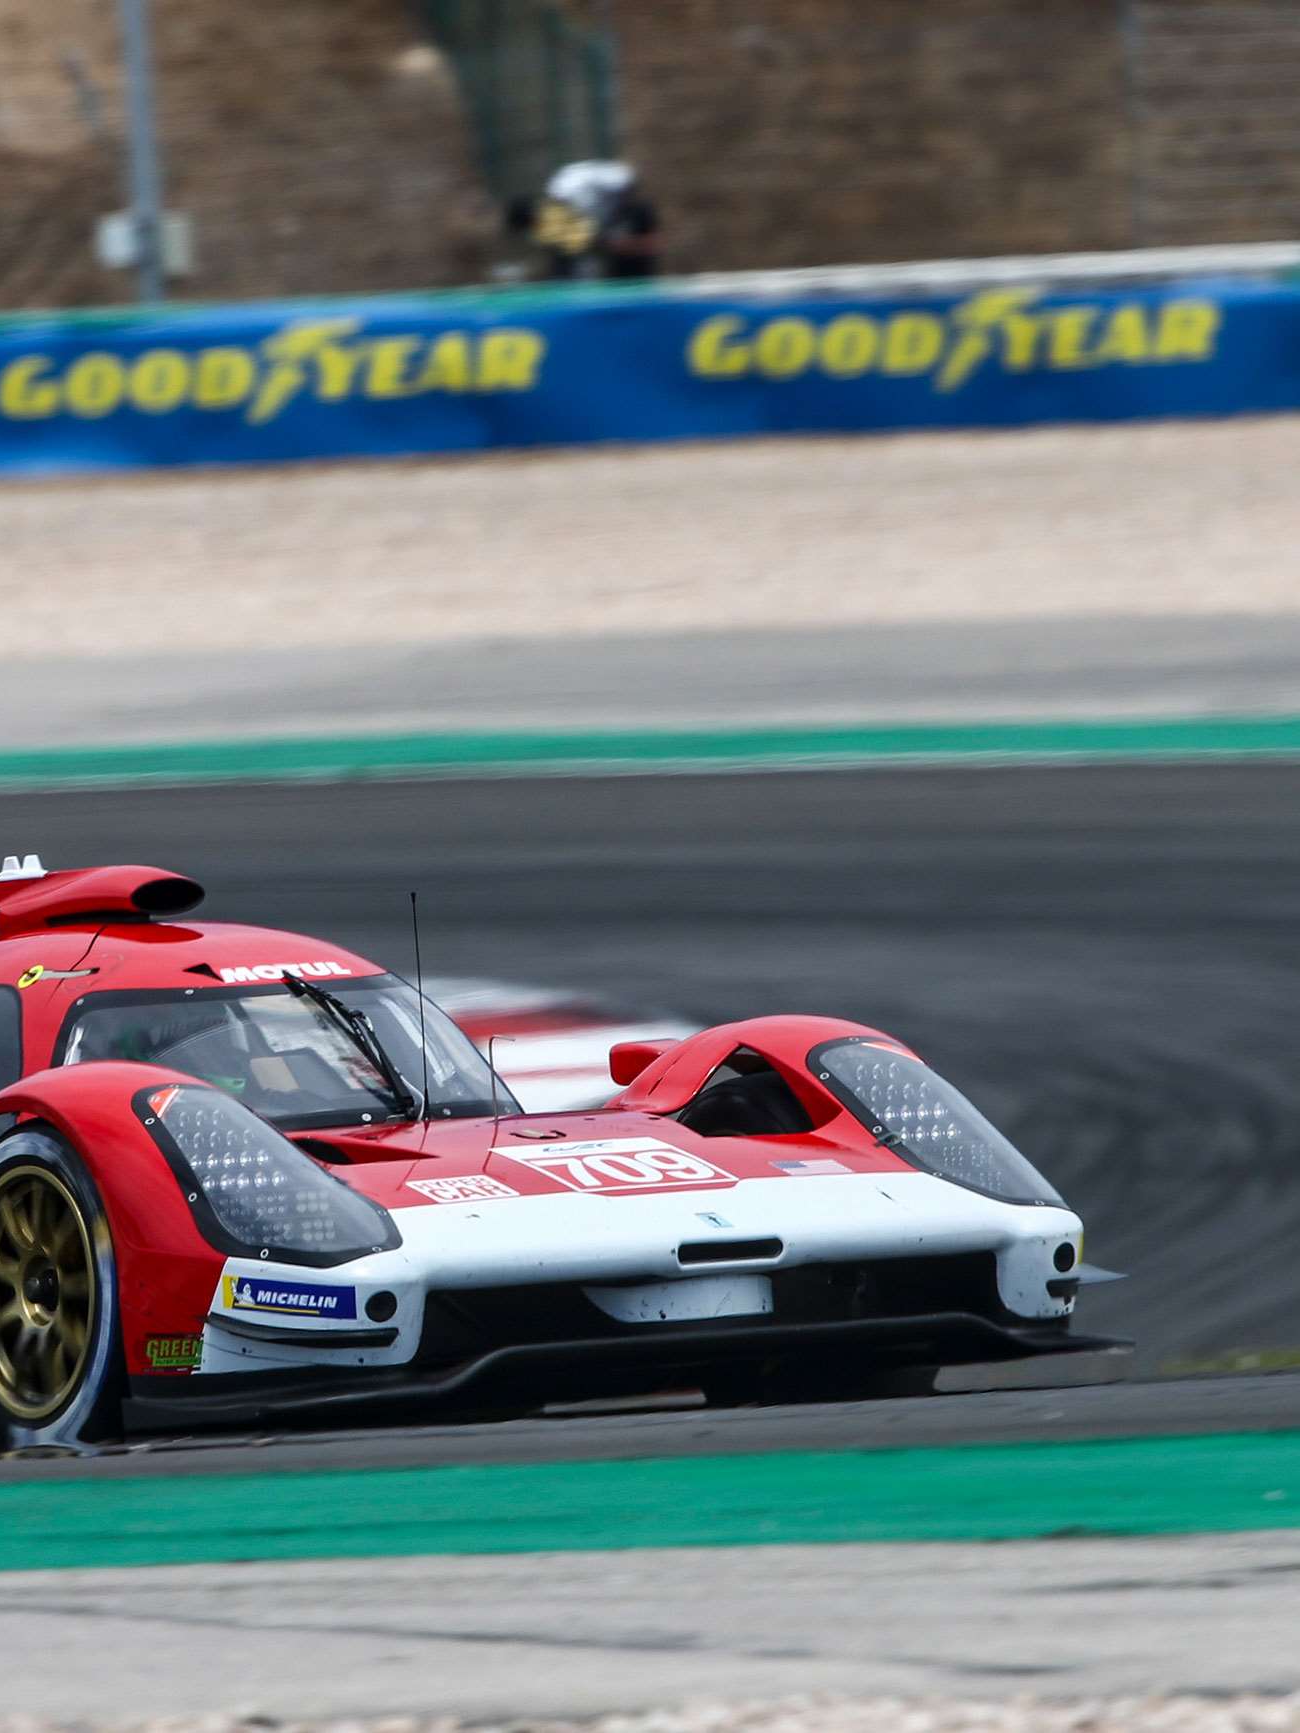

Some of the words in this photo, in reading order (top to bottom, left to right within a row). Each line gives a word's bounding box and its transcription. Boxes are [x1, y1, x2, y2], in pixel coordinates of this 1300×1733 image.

[688, 285, 1220, 393] GOODYEAR
[219, 962, 352, 983] MOTUL
[529, 1151, 715, 1187] 709
[413, 1177, 493, 1190] HYPER
[428, 1184, 512, 1200] CAR
[256, 1290, 338, 1309] MICHELIN
[146, 1339, 204, 1358] GREEN
